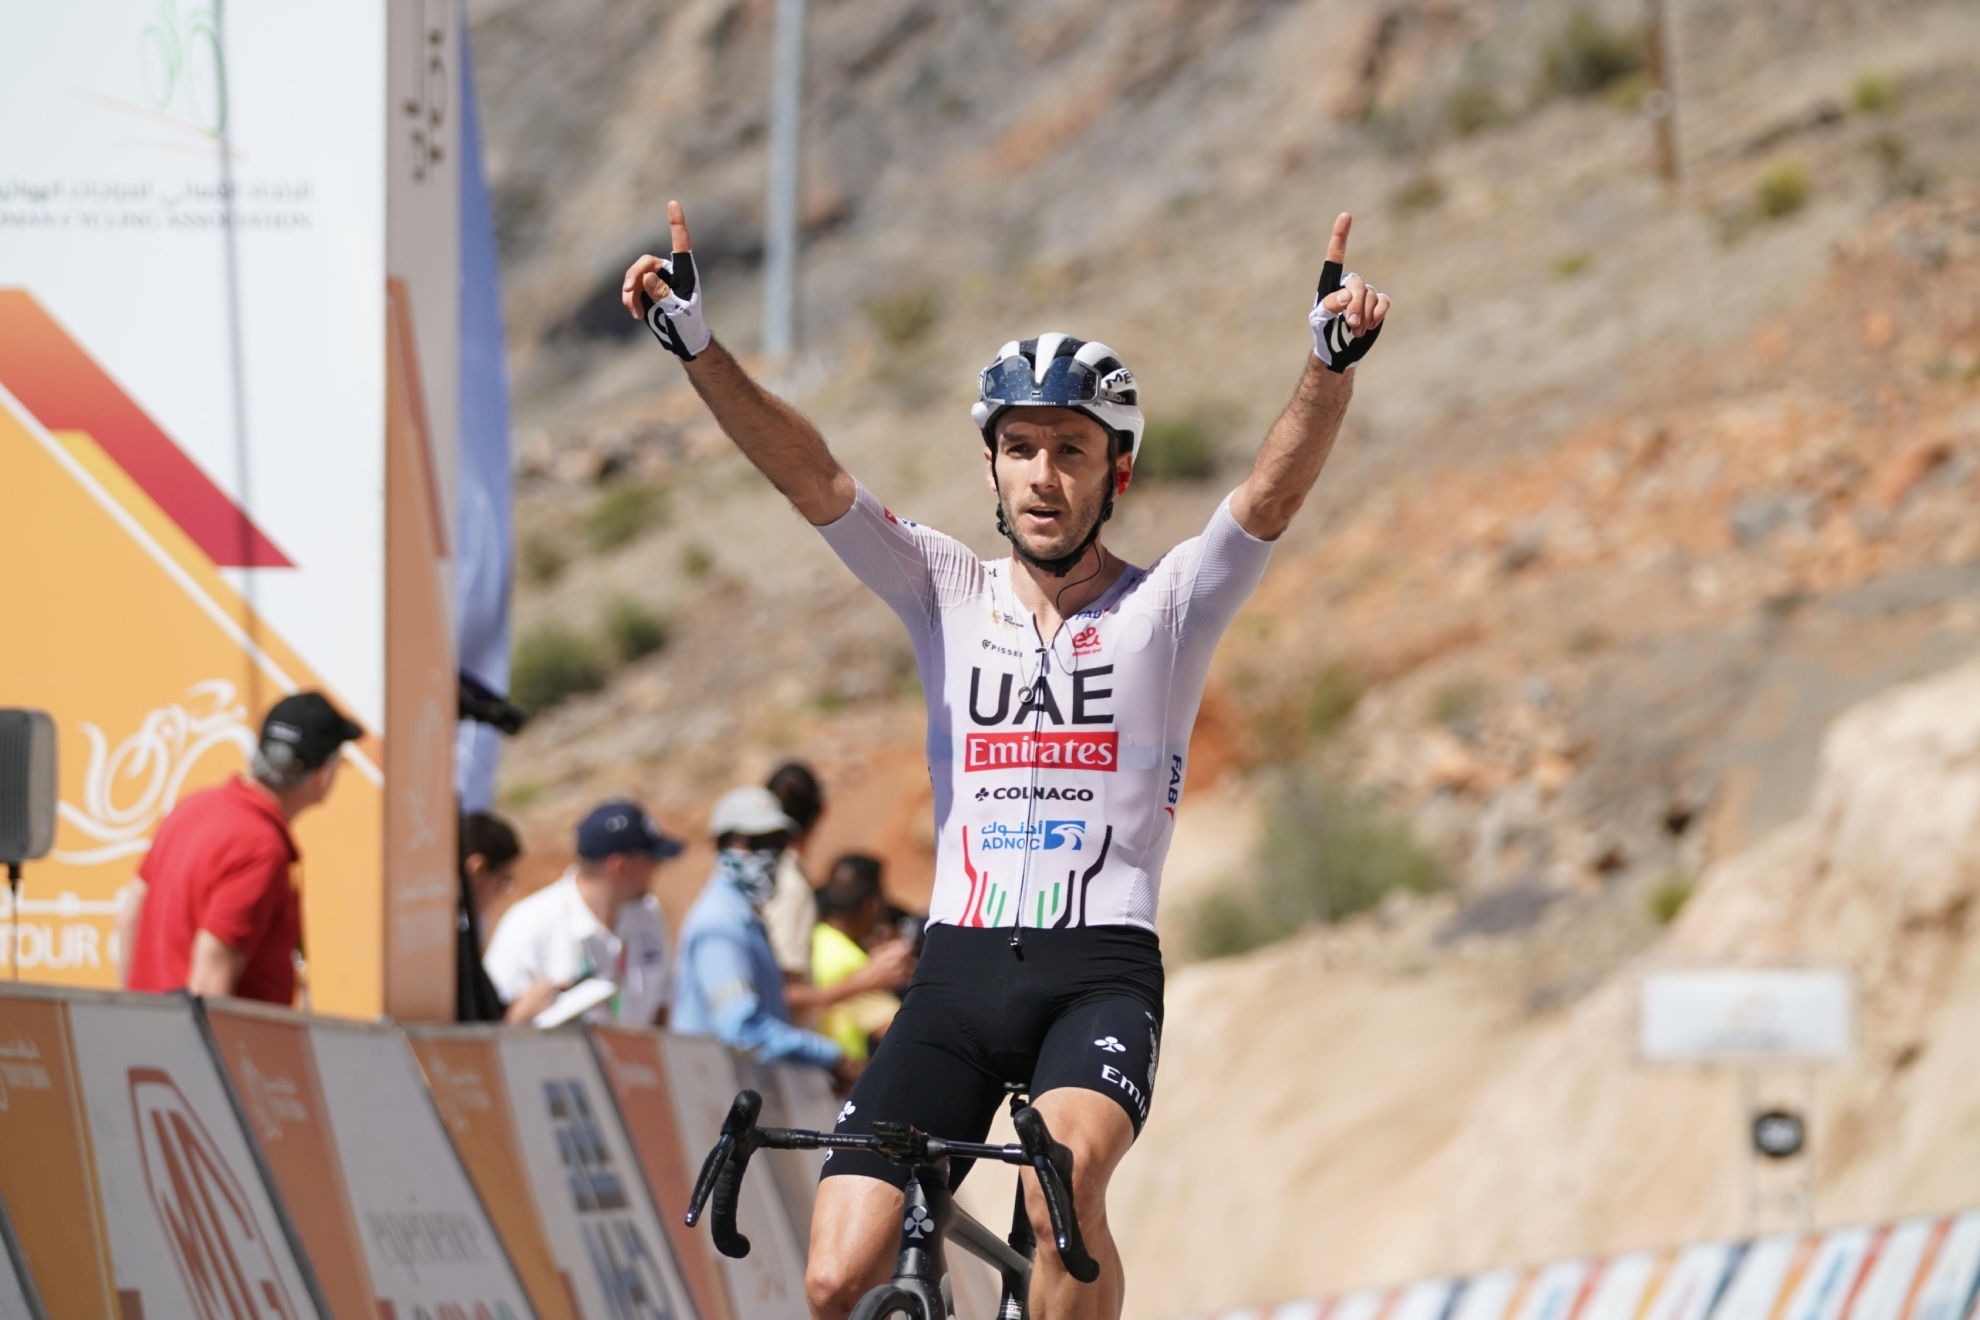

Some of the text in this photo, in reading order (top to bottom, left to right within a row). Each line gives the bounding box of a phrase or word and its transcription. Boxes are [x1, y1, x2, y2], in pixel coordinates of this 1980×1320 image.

[1075, 609, 1102, 621] FAB
[991, 644, 1023, 658] PISSEI
[969, 664, 1114, 726] UAE
[969, 735, 1113, 768] Emirates
[993, 787, 1094, 801] COLNAGO
[1168, 754, 1182, 805] FAB
[982, 837, 1041, 850] ADNOC
[0, 922, 100, 968] TOUR
[1101, 1064, 1147, 1118] Emir
